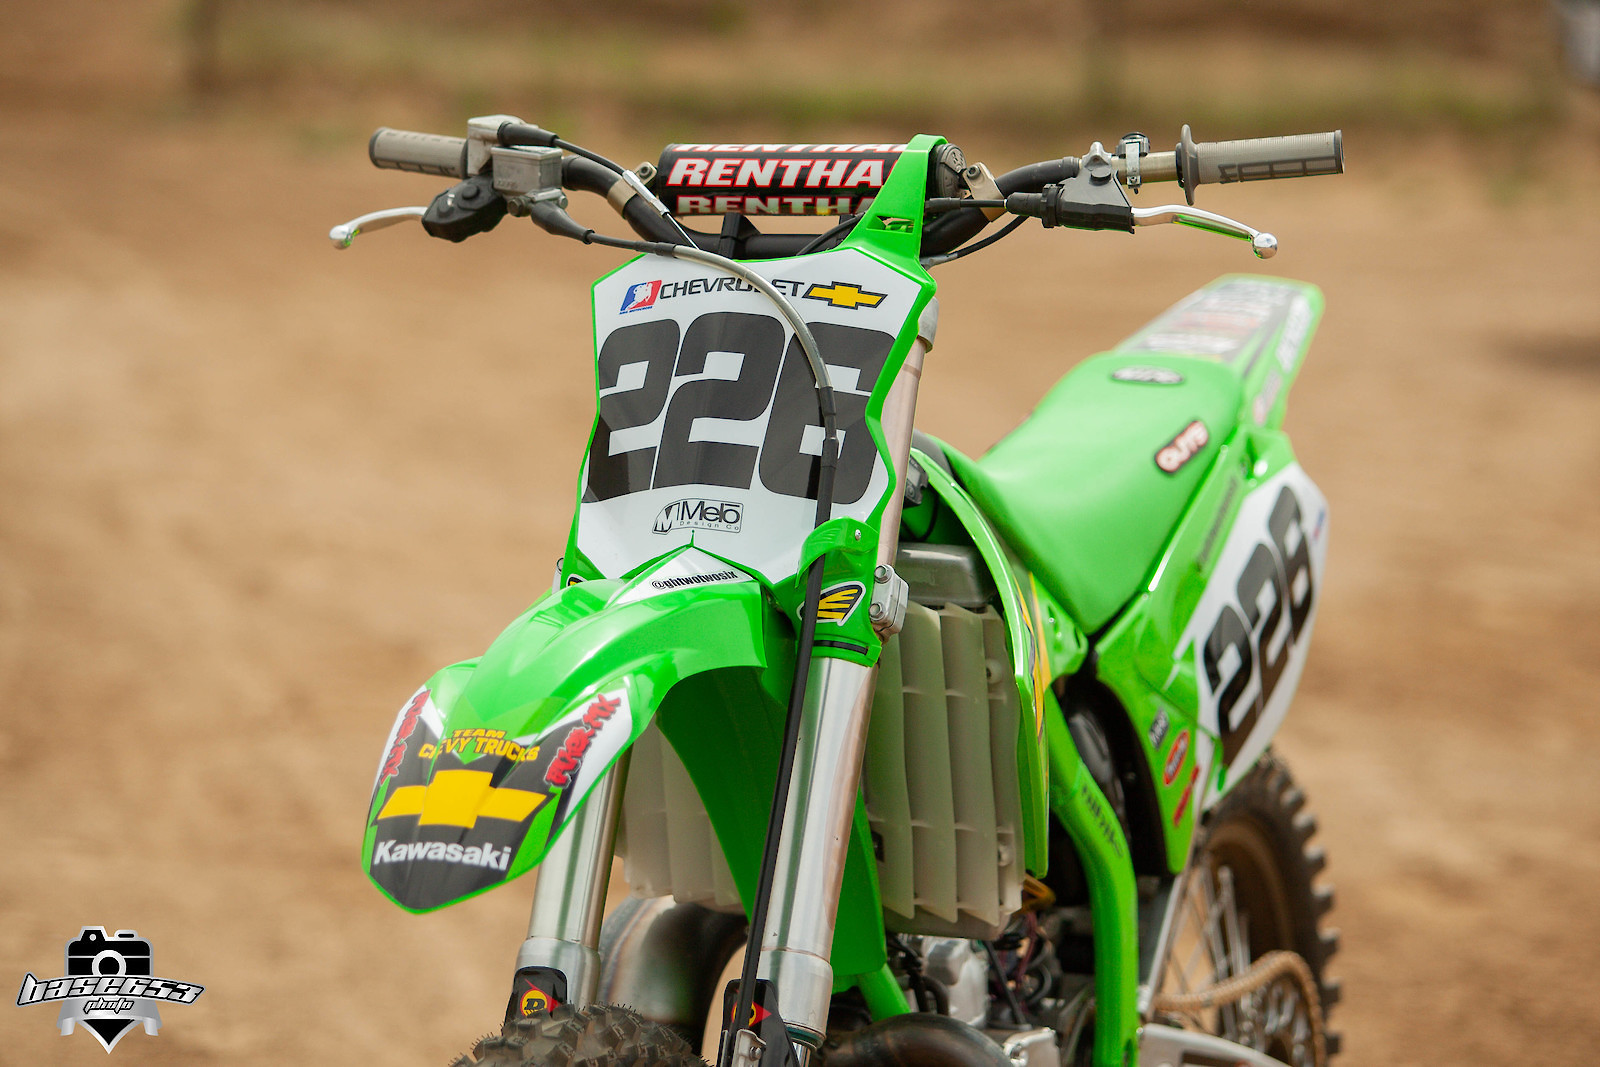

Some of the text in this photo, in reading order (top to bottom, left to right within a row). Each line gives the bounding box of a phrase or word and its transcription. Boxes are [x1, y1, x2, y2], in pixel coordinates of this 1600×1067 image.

[666, 158, 898, 188] RENTHA
[659, 277, 805, 299] CHEVROET
[582, 311, 897, 505] 226
[679, 520, 720, 528] Design
[1203, 485, 1314, 772] 226
[452, 728, 508, 739] TEAM
[373, 840, 512, 871] Kawasaki
